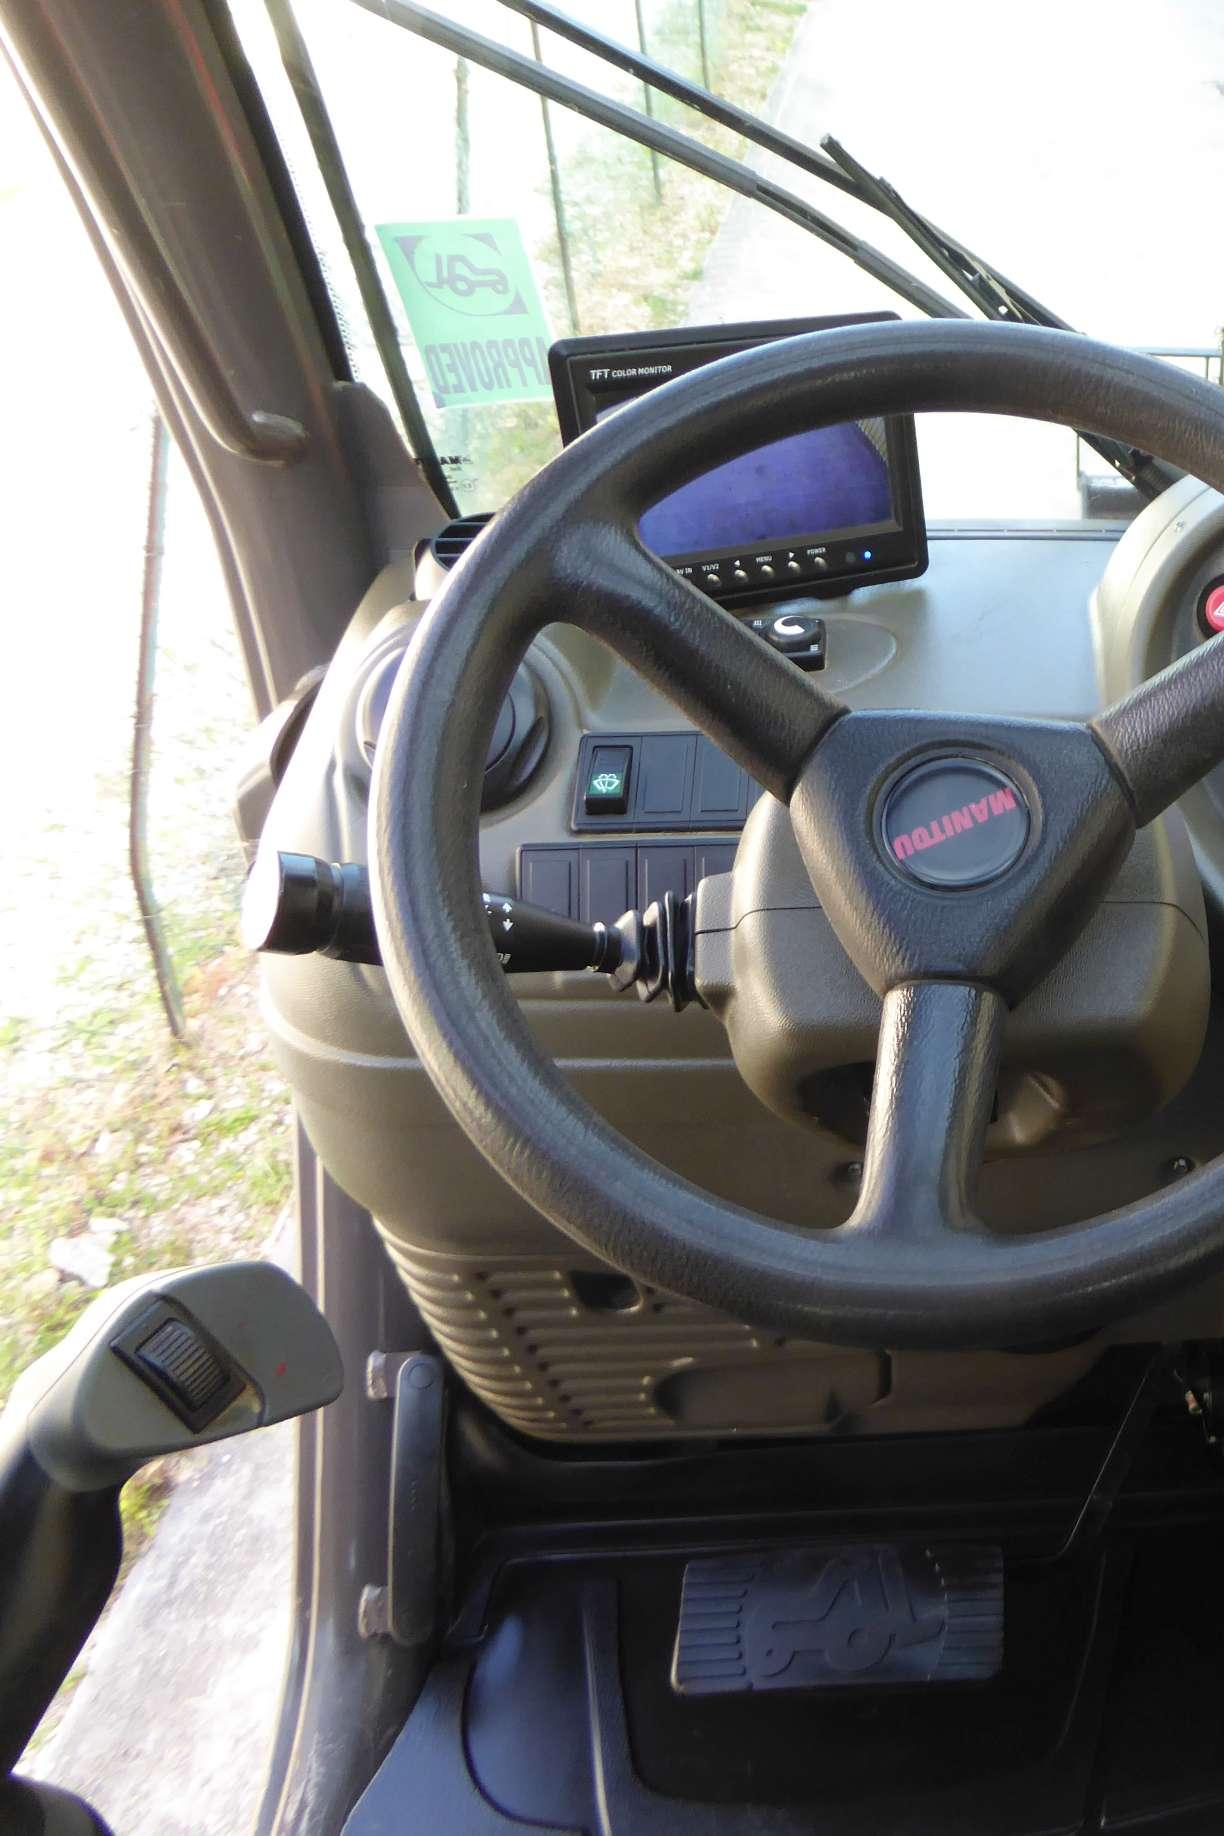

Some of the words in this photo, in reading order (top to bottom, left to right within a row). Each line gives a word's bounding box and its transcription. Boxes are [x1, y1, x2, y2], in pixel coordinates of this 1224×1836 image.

[590, 368, 610, 380] TFT
[611, 368, 637, 378] COLOR
[638, 364, 672, 375] MONITOR
[893, 787, 1017, 860] MANITOU
